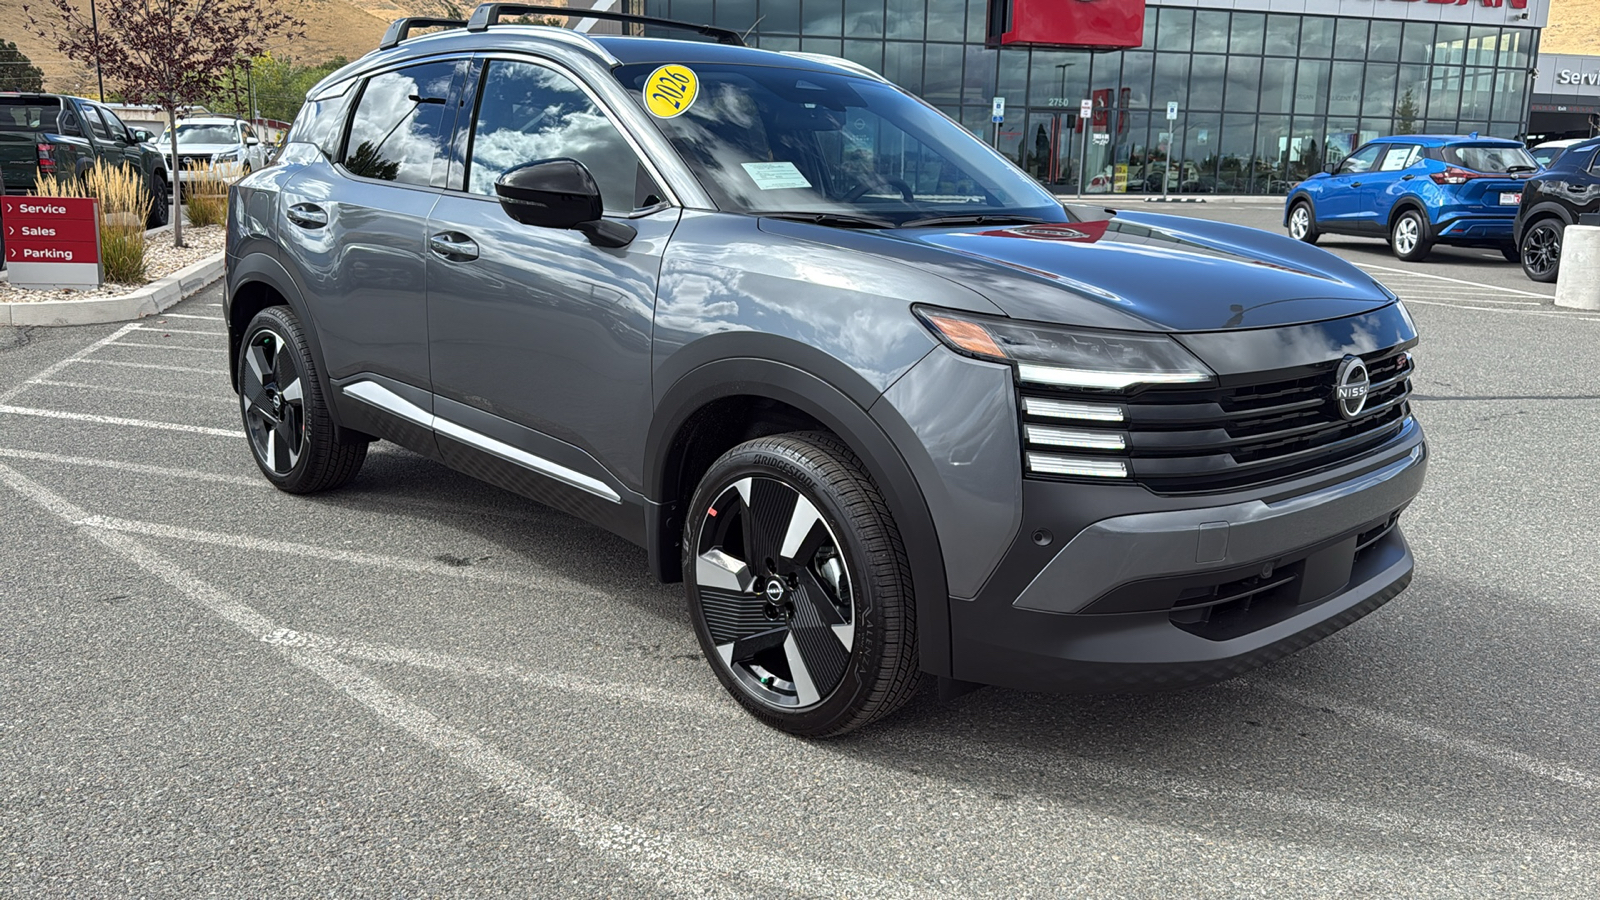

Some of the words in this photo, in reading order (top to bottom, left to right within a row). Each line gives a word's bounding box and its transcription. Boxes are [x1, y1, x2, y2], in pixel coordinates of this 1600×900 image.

[652, 68, 690, 110] 2026
[1048, 98, 1069, 107] 2750
[19, 203, 67, 214] Service
[21, 226, 56, 236] Sales
[23, 248, 73, 261] Parking
[1339, 386, 1368, 398] NISS
[752, 453, 819, 491] BRIDGESTONE
[860, 619, 874, 673] ALENZA
